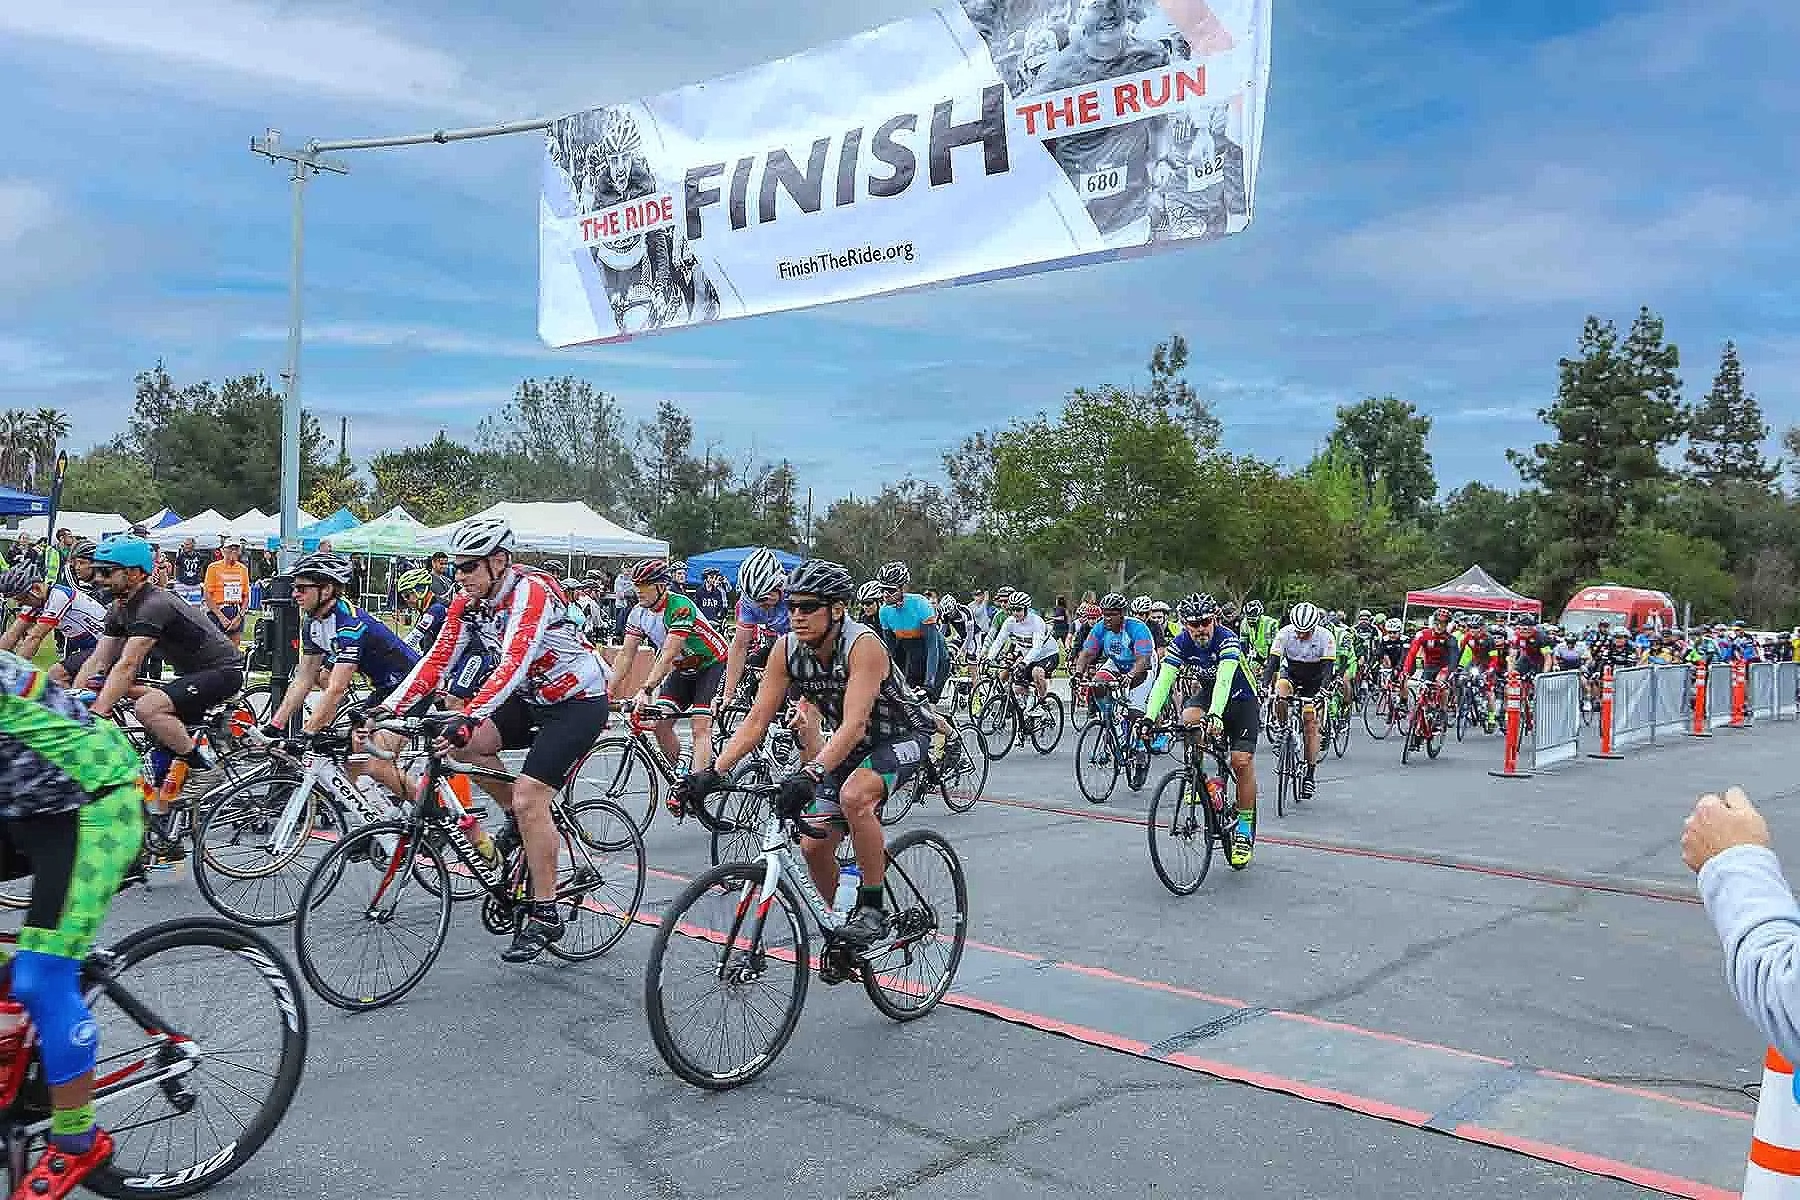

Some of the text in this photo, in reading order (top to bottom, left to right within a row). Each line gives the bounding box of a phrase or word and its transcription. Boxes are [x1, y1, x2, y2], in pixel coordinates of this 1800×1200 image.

[1015, 63, 1207, 135] THE RUN
[684, 83, 1010, 241] FINISH
[1086, 171, 1119, 193] 680
[1194, 155, 1224, 179] 682
[580, 196, 673, 242] THE RIDE
[778, 242, 914, 279] FinishTheRide.org
[331, 776, 381, 824] cervé
[439, 815, 500, 886] SPECIALIZED
